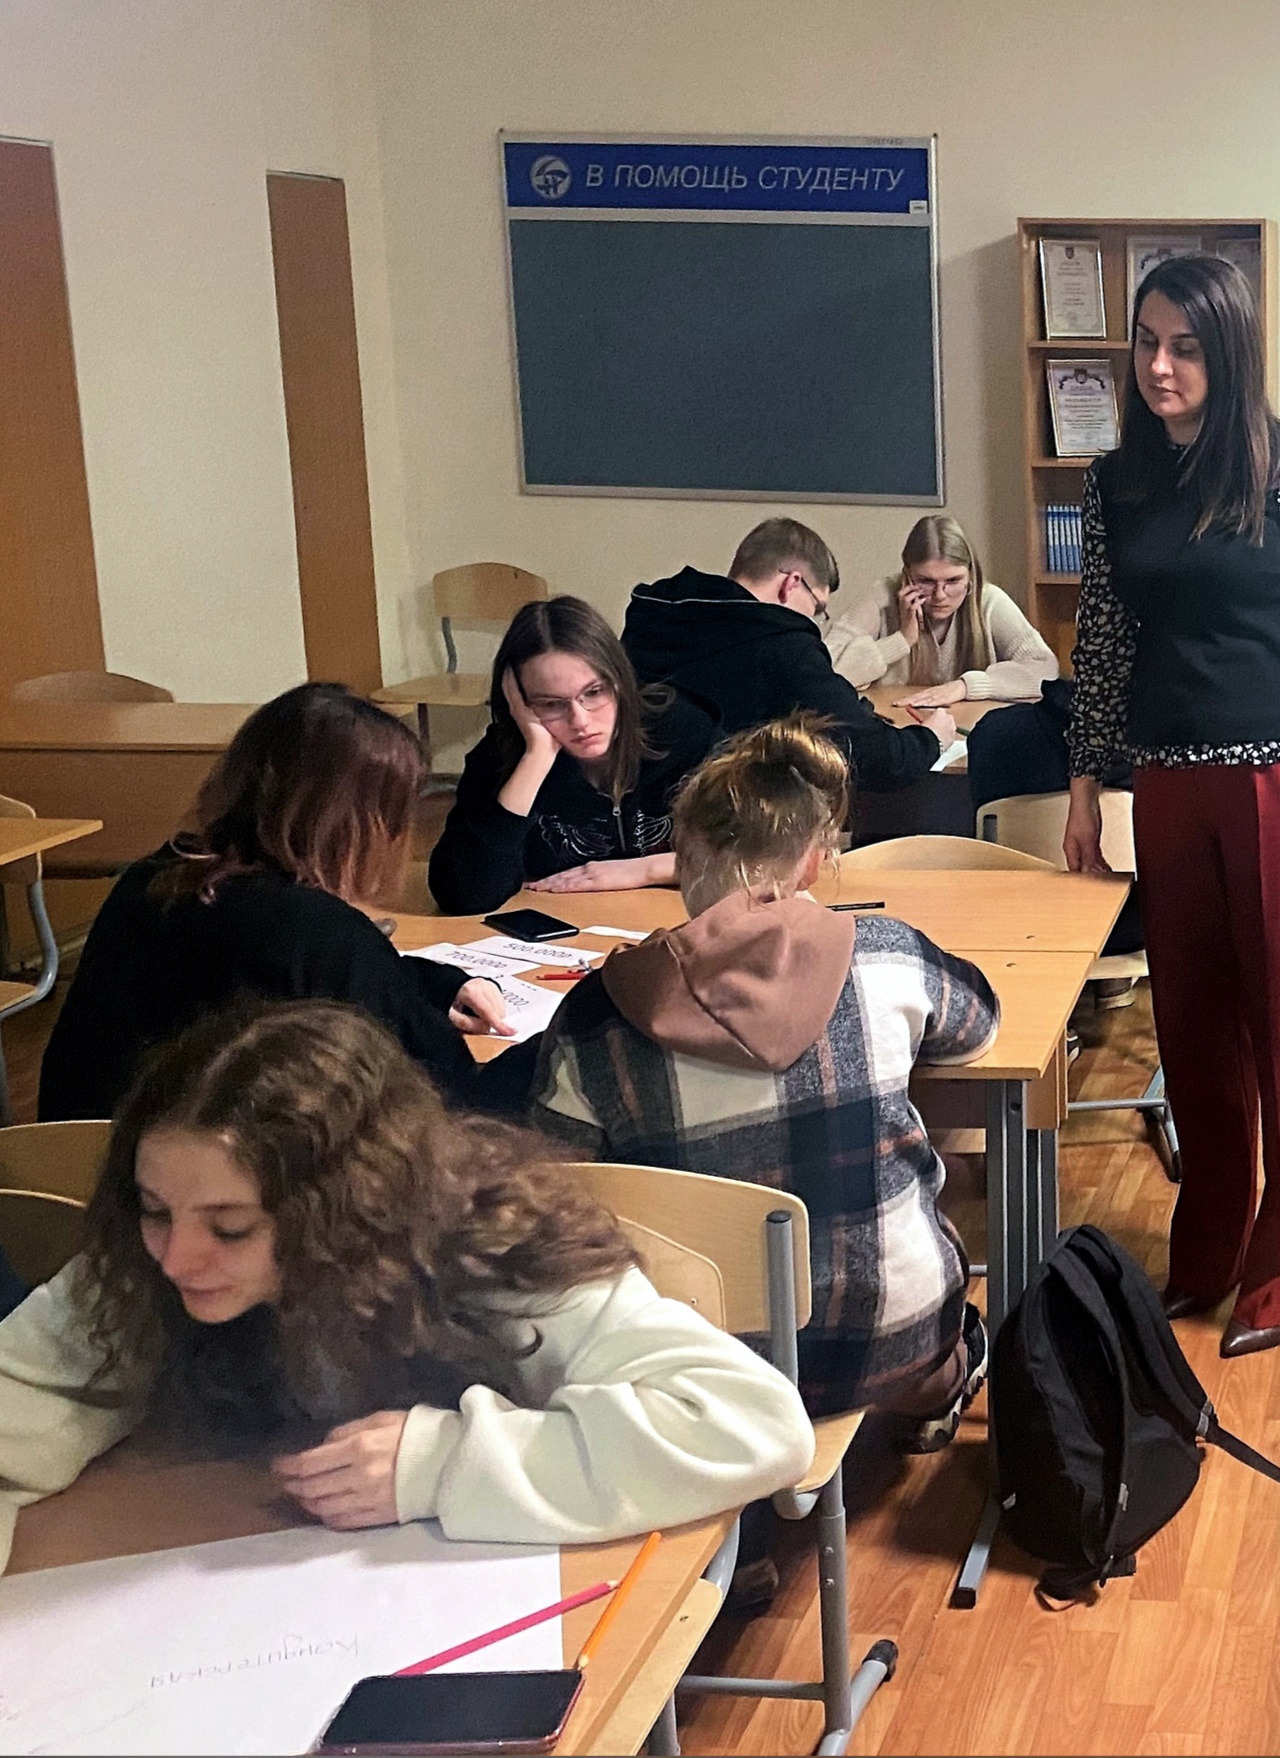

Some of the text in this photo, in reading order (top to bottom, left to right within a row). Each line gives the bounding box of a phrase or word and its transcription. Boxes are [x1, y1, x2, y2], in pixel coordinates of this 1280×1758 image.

[586, 164, 905, 195] В ПОМОЩЬ СТУДЕНТУ
